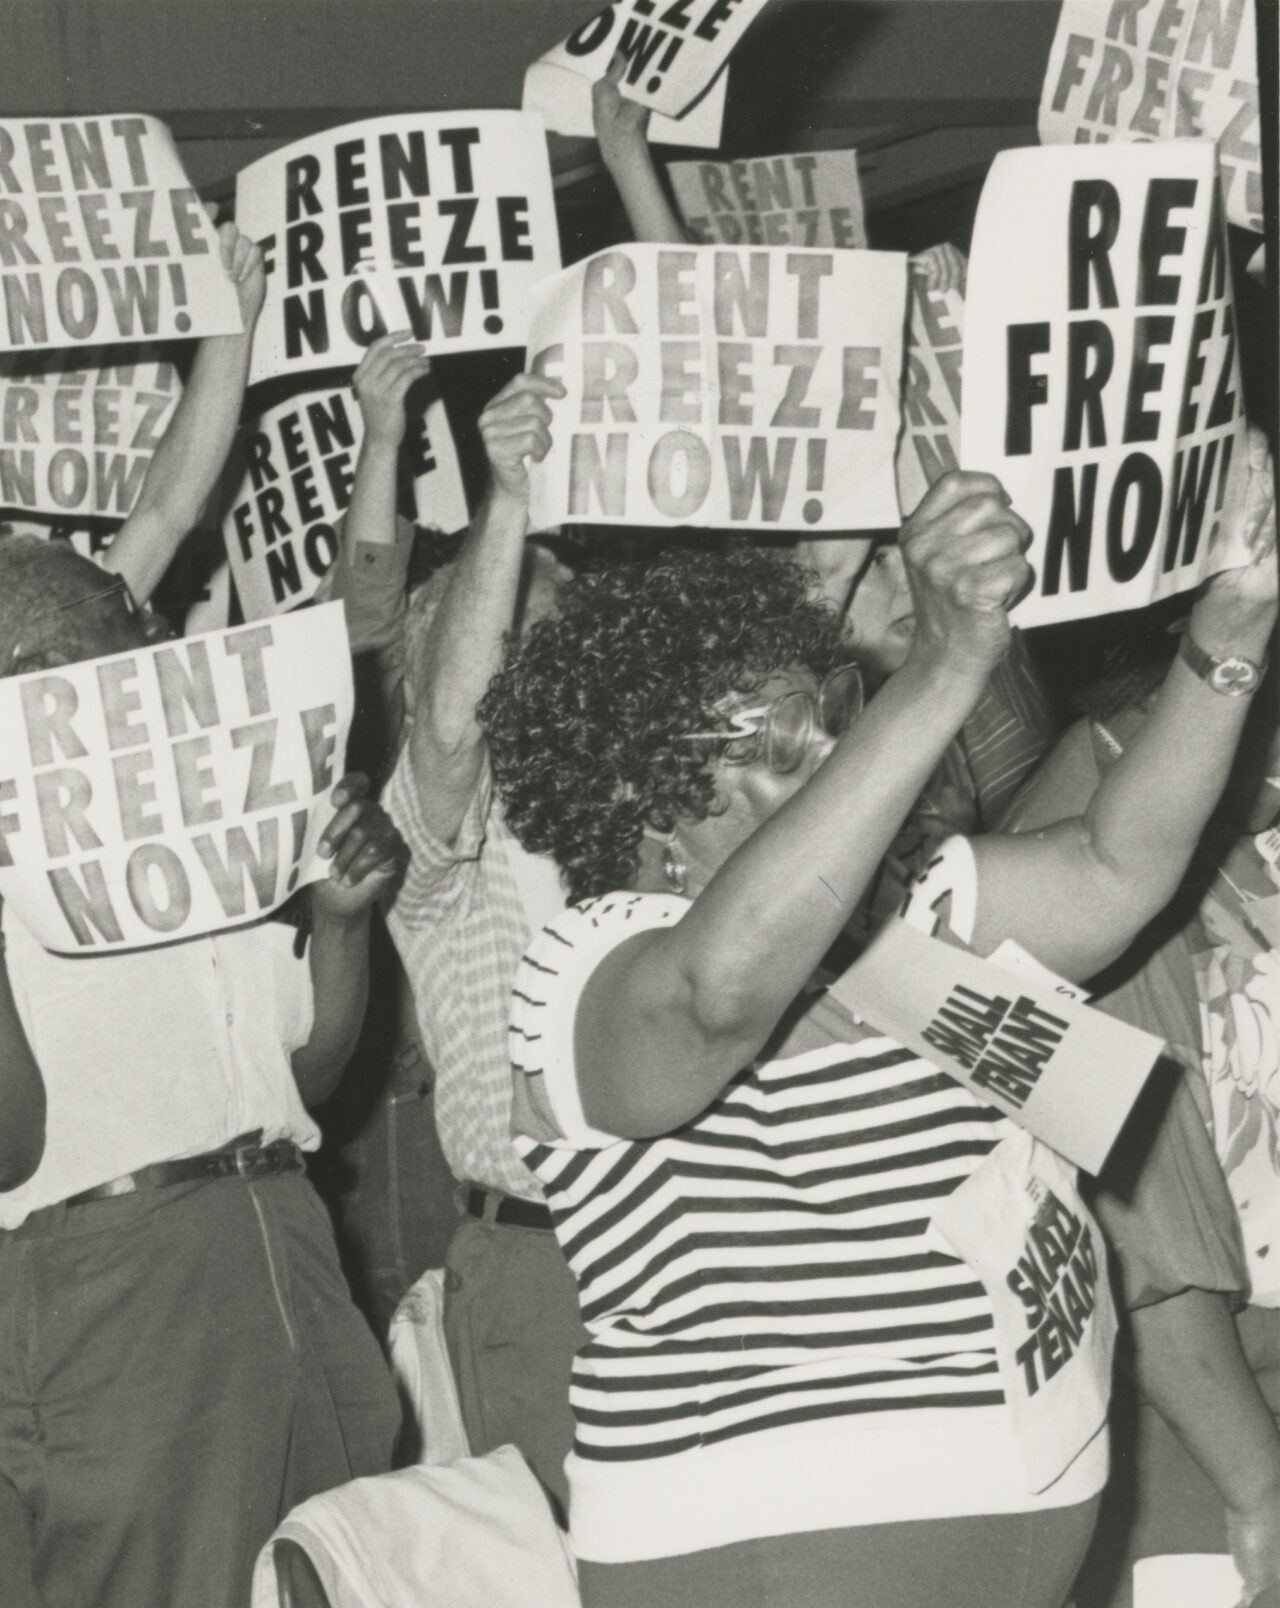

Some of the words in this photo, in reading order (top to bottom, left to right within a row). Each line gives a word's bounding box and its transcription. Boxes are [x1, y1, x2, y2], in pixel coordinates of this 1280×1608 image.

[565, 5, 685, 94] OW!
[1105, 0, 1248, 70] REN
[1051, 33, 1260, 163] FREEZ
[286, 126, 480, 224] RENT
[698, 155, 817, 213] RENT
[1067, 177, 1226, 311] REN
[1, 263, 191, 346] NOW!
[283, 268, 504, 359] NOW!
[582, 251, 834, 340] RENT
[1004, 304, 1244, 457] FREEZ
[247, 393, 356, 492] REN
[567, 430, 828, 524] NOW!
[265, 522, 339, 604] NO
[1040, 434, 1236, 597] NOW!
[20, 624, 275, 768] RENT
[46, 808, 310, 947] NOW!
[920, 983, 1012, 1070] SMALL
[970, 995, 1071, 1111] TENANT
[1006, 1189, 1082, 1331] SMALL
[1015, 1222, 1099, 1397] TENANT
